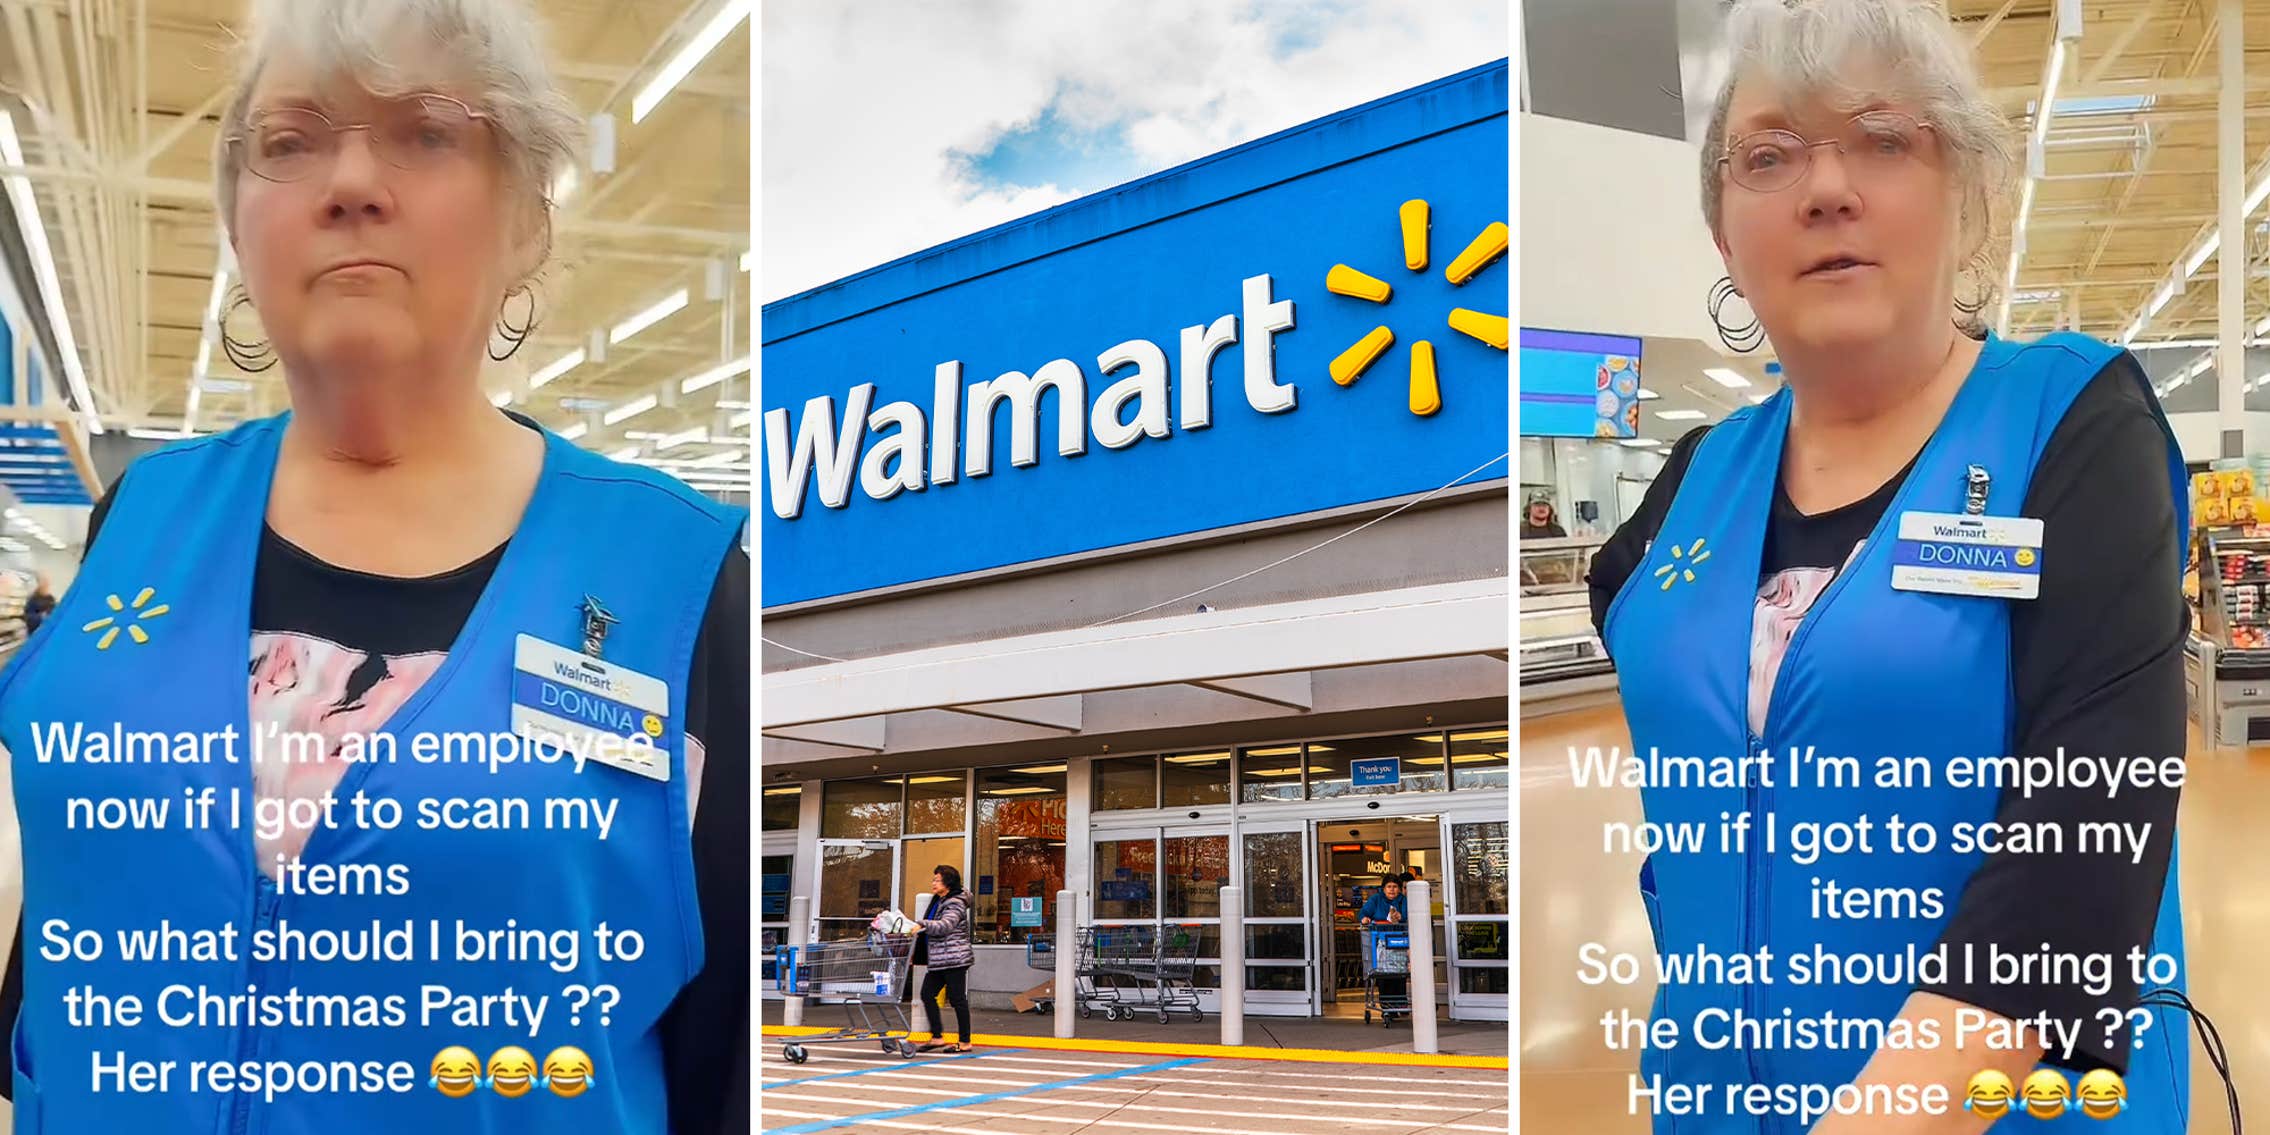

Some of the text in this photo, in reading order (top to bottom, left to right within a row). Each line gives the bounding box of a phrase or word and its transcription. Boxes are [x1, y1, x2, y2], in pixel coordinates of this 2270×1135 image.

[764, 273, 1296, 519] Walmart
[1934, 525, 1987, 540] Walmart
[1919, 543, 2008, 568] DONNA
[554, 660, 612, 692] Walmart
[541, 681, 635, 732] DONNA
[1358, 764, 1379, 774] Thank
[1041, 819, 1067, 836] Here
